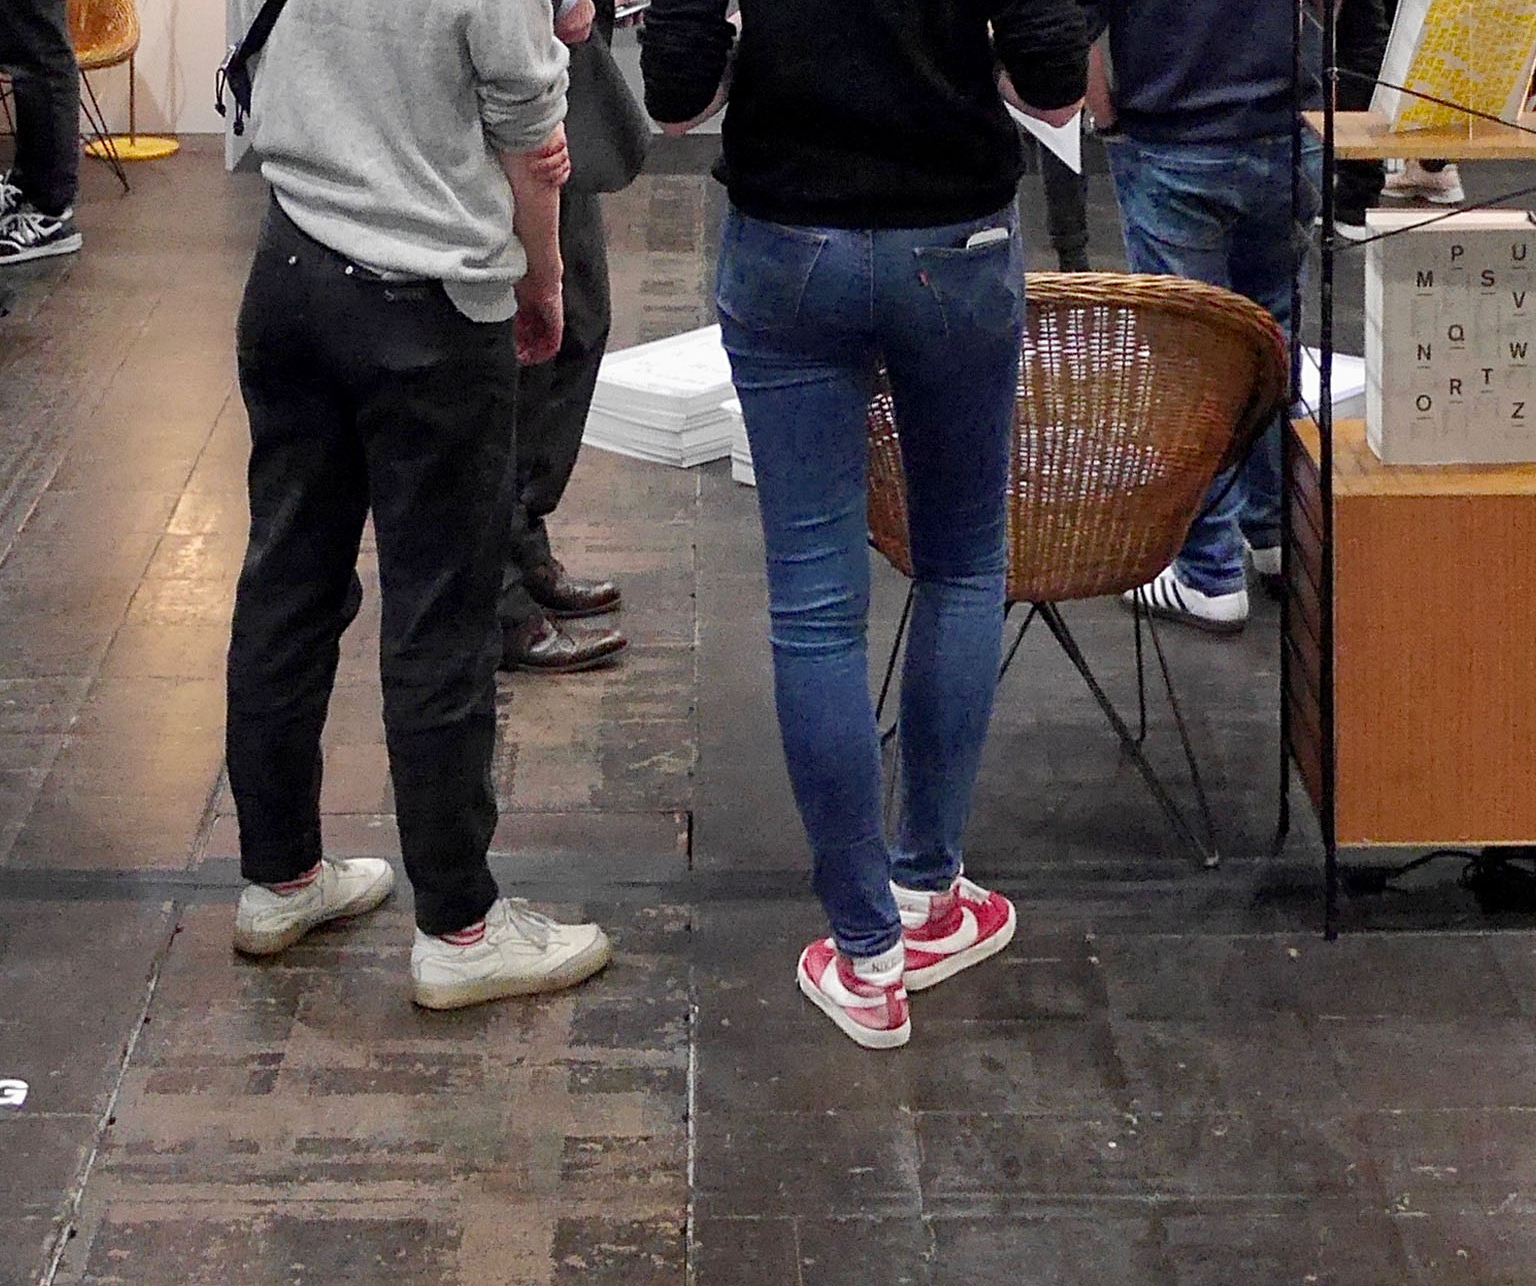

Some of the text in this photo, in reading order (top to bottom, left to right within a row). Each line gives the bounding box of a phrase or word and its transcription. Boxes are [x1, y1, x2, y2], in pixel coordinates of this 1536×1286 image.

[1451, 243, 1527, 262] P U
[1417, 270, 1495, 288] M S
[1512, 291, 1526, 309] V
[1448, 324, 1465, 342] Q
[1417, 342, 1528, 361] N W
[1481, 368, 1494, 385] T
[1449, 378, 1463, 395] R
[1416, 394, 1525, 419] O Z
[872, 958, 898, 973] NIKE
